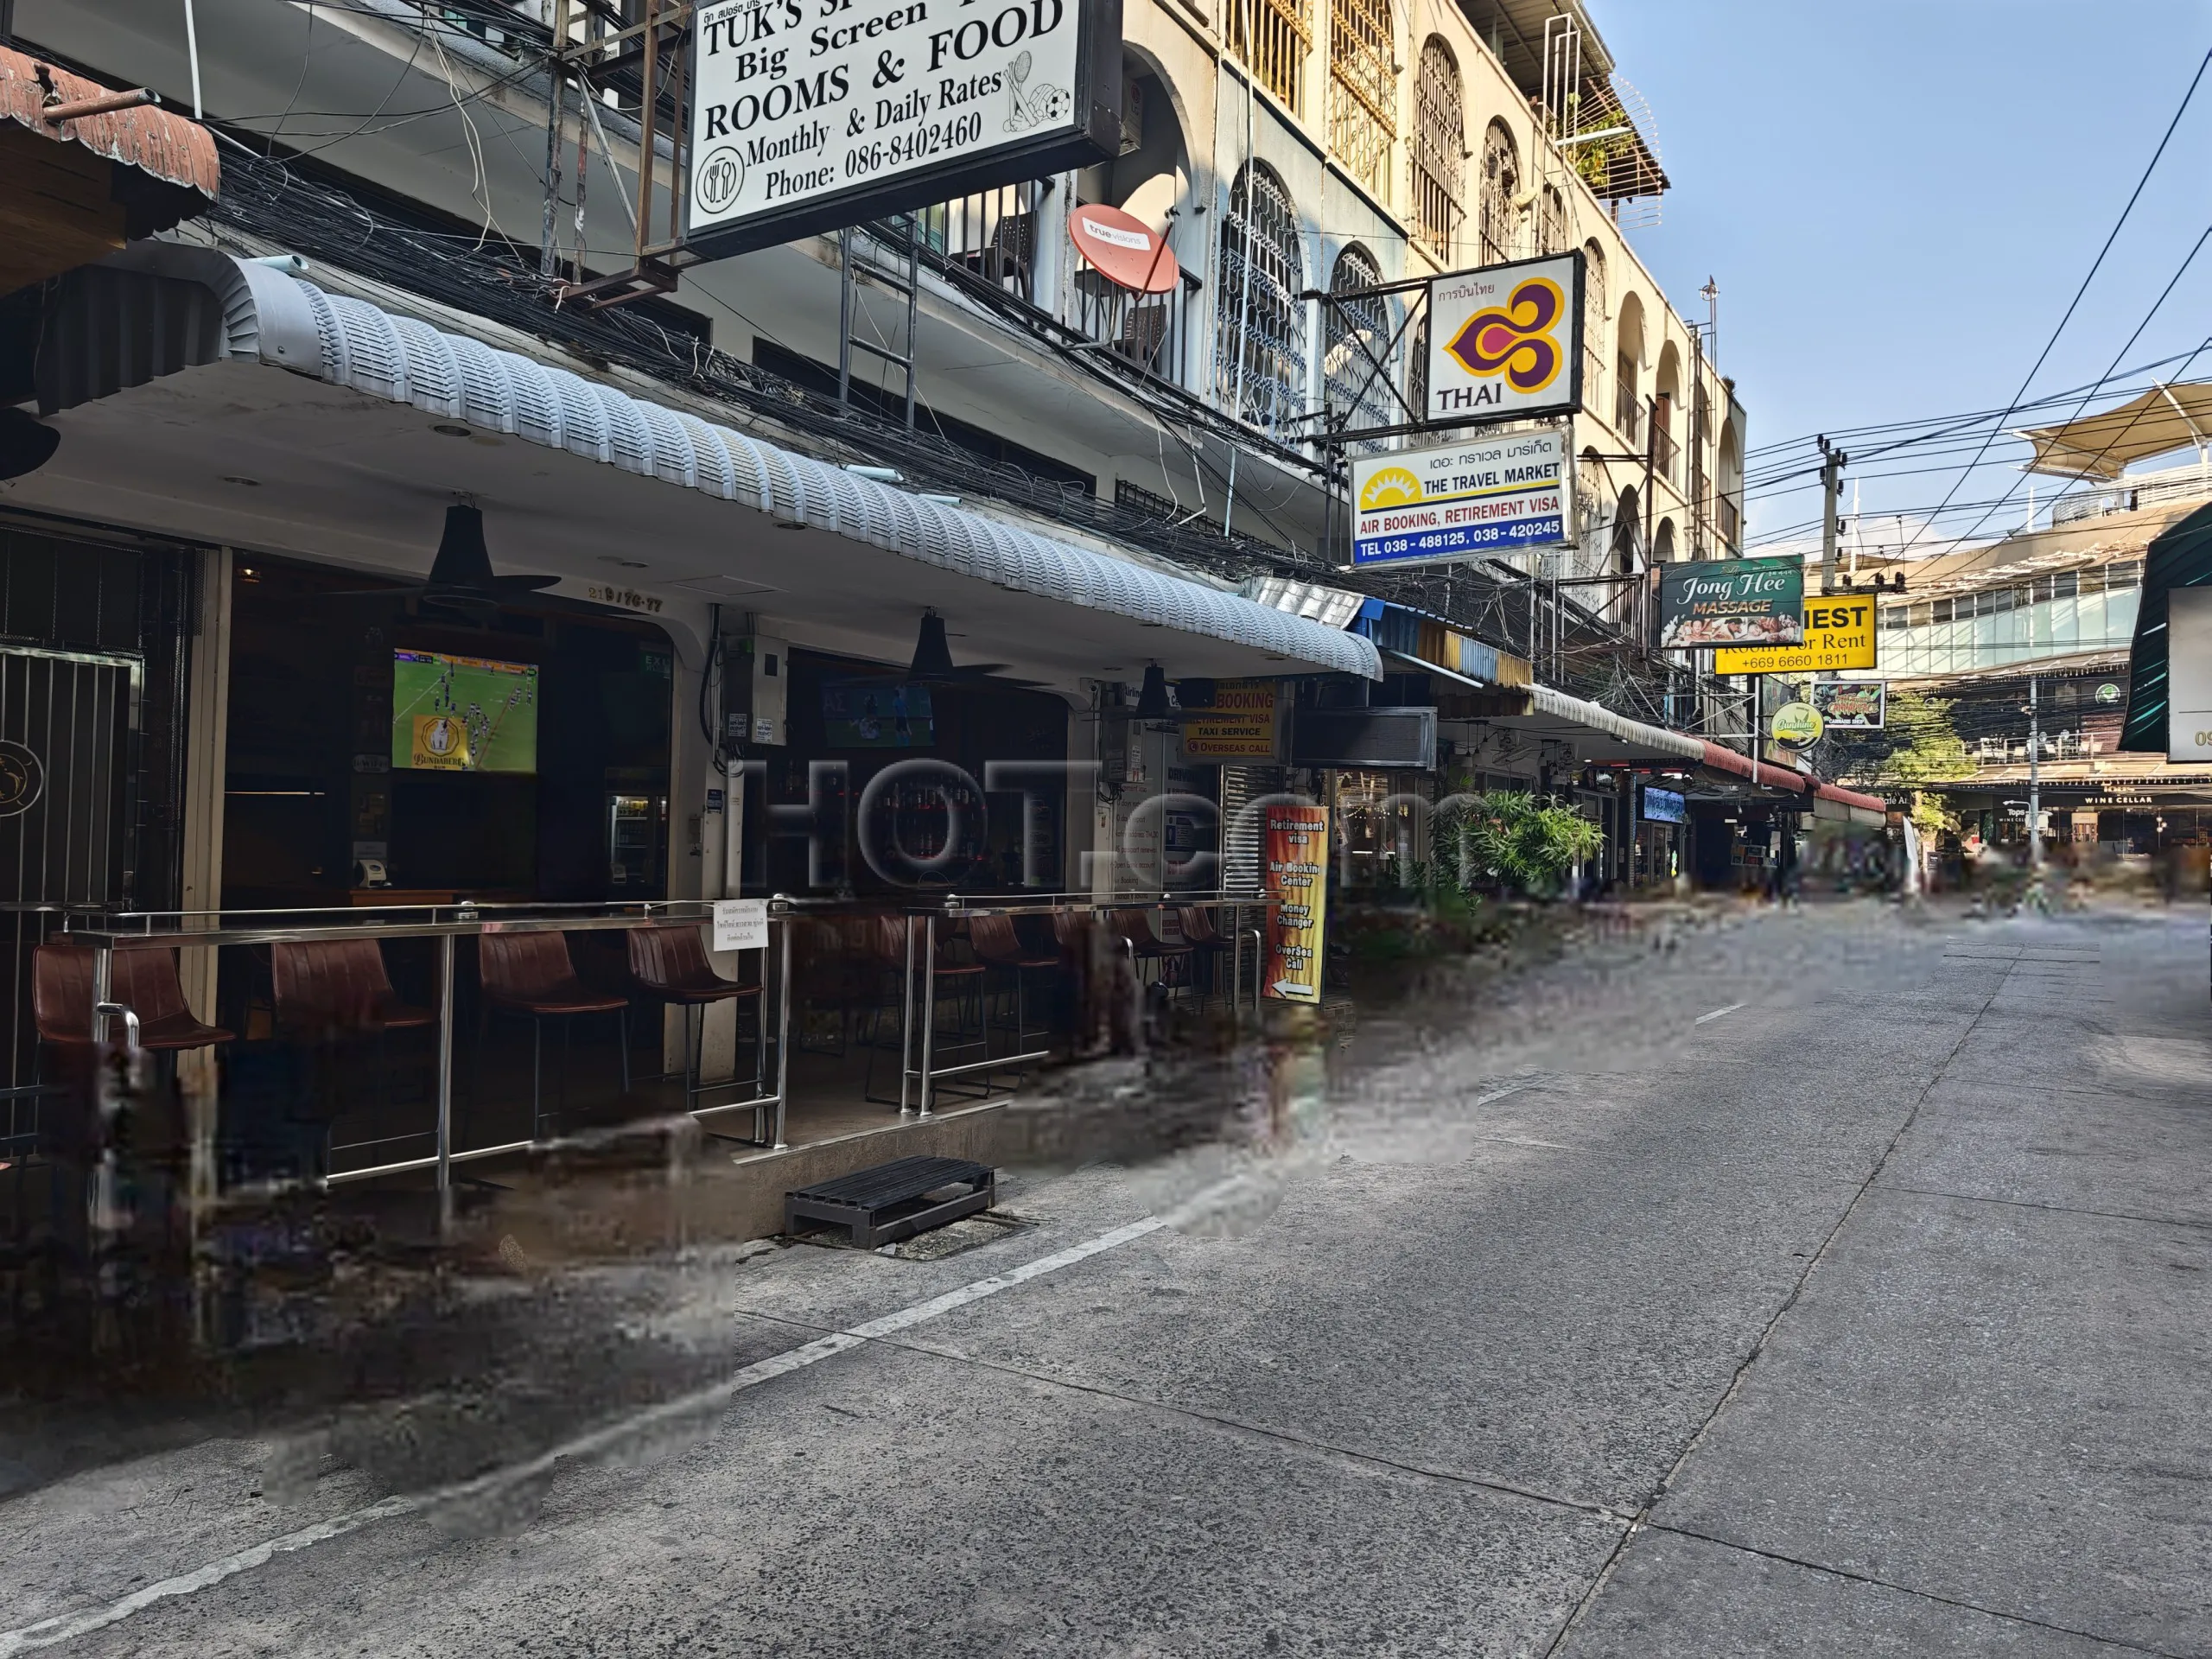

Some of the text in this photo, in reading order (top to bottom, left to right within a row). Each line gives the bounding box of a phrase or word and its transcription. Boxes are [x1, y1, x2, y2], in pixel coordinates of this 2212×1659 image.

[734, 1, 928, 83] Big Screen
[703, 0, 1063, 141] ROOMS & FOOD
[746, 71, 1001, 168] Monthly & Daily Rates
[765, 111, 982, 200] Phone: 086-8402460
[1090, 224, 1141, 245] true visions
[1439, 282, 1495, 302] การบินไทย
[1436, 383, 1503, 410] THAI
[1430, 457, 1453, 469] เดอะ
[1508, 439, 1552, 458] มาร์เก็ต
[1424, 462, 1560, 494] THE TRAVEL MARKET
[1360, 496, 1559, 534] AIR BOOKING, RETIREMENT VISA
[1361, 542, 1381, 556] TEL
[1676, 574, 1785, 605] Jong Hee
[1692, 600, 1772, 614] MASSAGE
[1823, 633, 1866, 649] Rent
[1742, 653, 1847, 669] +669 6660 1811
[1216, 692, 1274, 709] BOOKING
[1249, 714, 1270, 724] VISA
[1198, 728, 1262, 736] TAXI SERVICE
[1249, 744, 1270, 753] CALL
[1884, 796, 1897, 804] afé
[2007, 808, 2025, 817] Tops
[1270, 818, 1325, 831] Retirement
[1288, 832, 1308, 844] visa
[1269, 861, 1283, 872] Air
[1281, 874, 1313, 887] Center
[1280, 904, 1310, 916] Money
[1276, 914, 1314, 929] Changer
[1275, 944, 1313, 958] OverSea
[1286, 957, 1304, 970] Call
